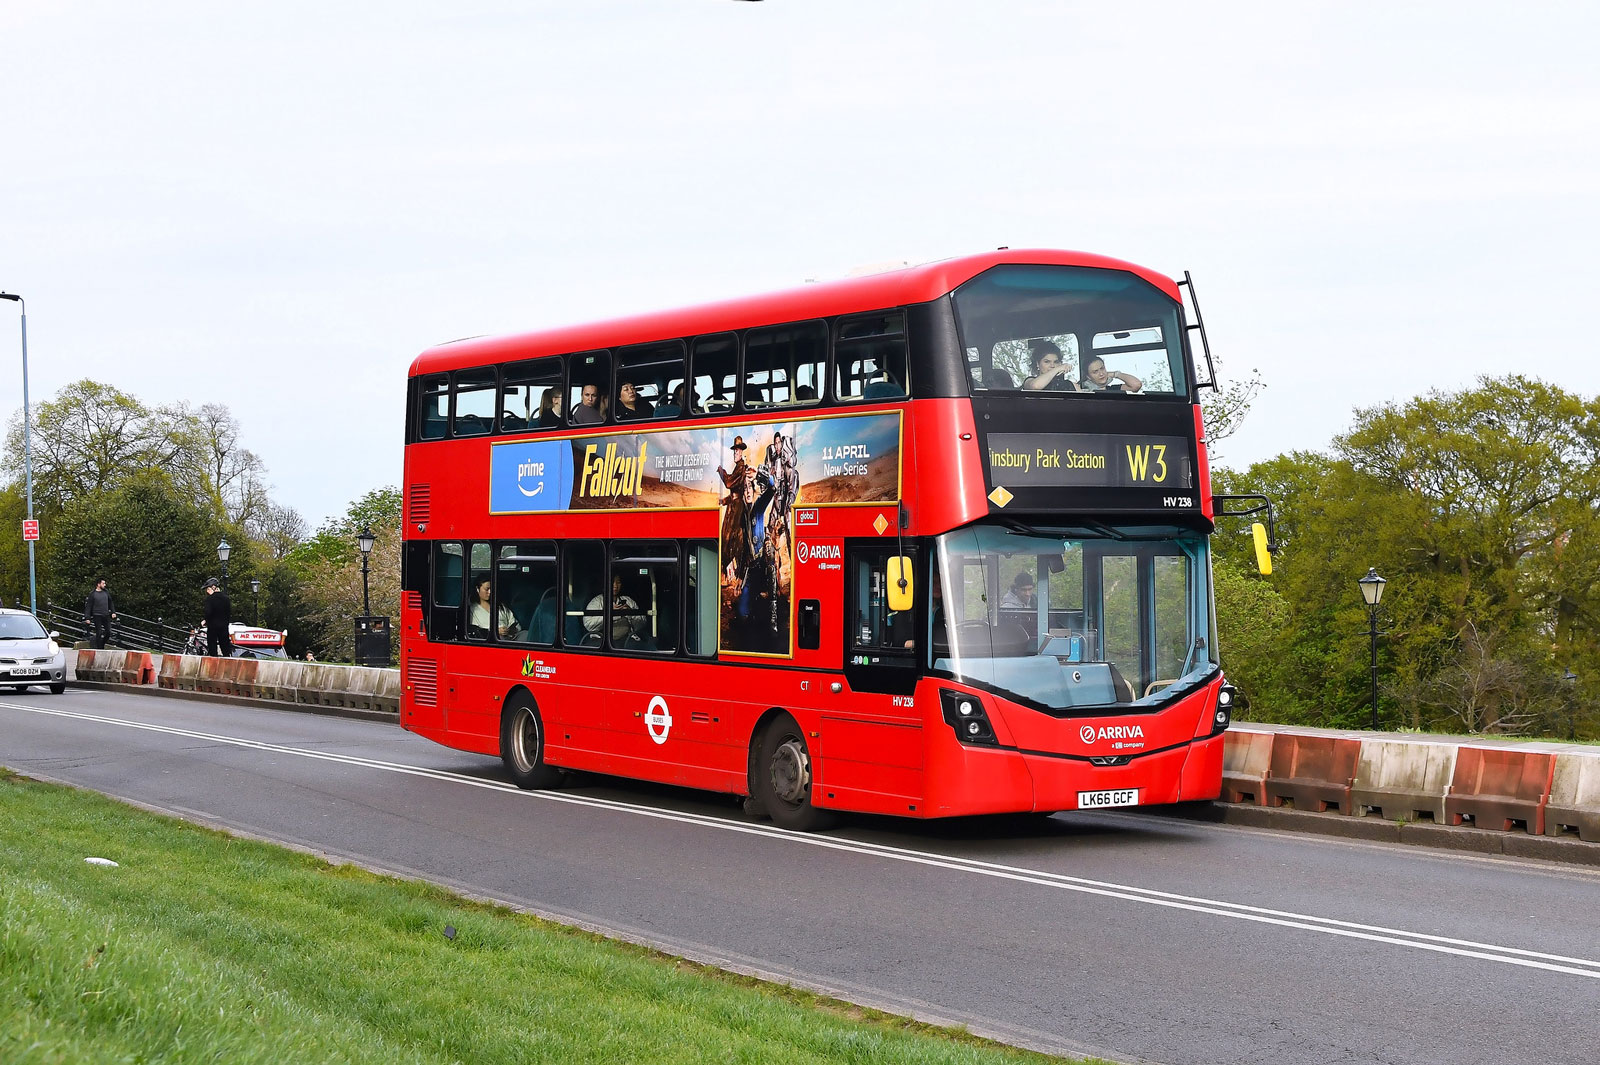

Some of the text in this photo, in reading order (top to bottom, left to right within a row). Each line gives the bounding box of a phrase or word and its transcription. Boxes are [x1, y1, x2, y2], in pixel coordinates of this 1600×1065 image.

[822, 444, 871, 460] 11 APRIL
[1036, 448, 1060, 468] Park
[1066, 449, 1105, 469] Station
[655, 452, 710, 469] THE WORLD DESERVES
[1126, 444, 1168, 483] W3
[518, 459, 544, 480] prime
[579, 441, 647, 500] Fallout
[659, 468, 704, 483] A BETTER ENDING
[823, 462, 868, 477] New Series
[1163, 496, 1193, 508] HV 238
[800, 512, 814, 522] global
[809, 545, 841, 559] ARRIVA
[800, 681, 810, 691] CT
[892, 696, 914, 707] HV 238
[1097, 726, 1144, 739] ARRIVA
[1083, 791, 1134, 805] LK66 GCF
